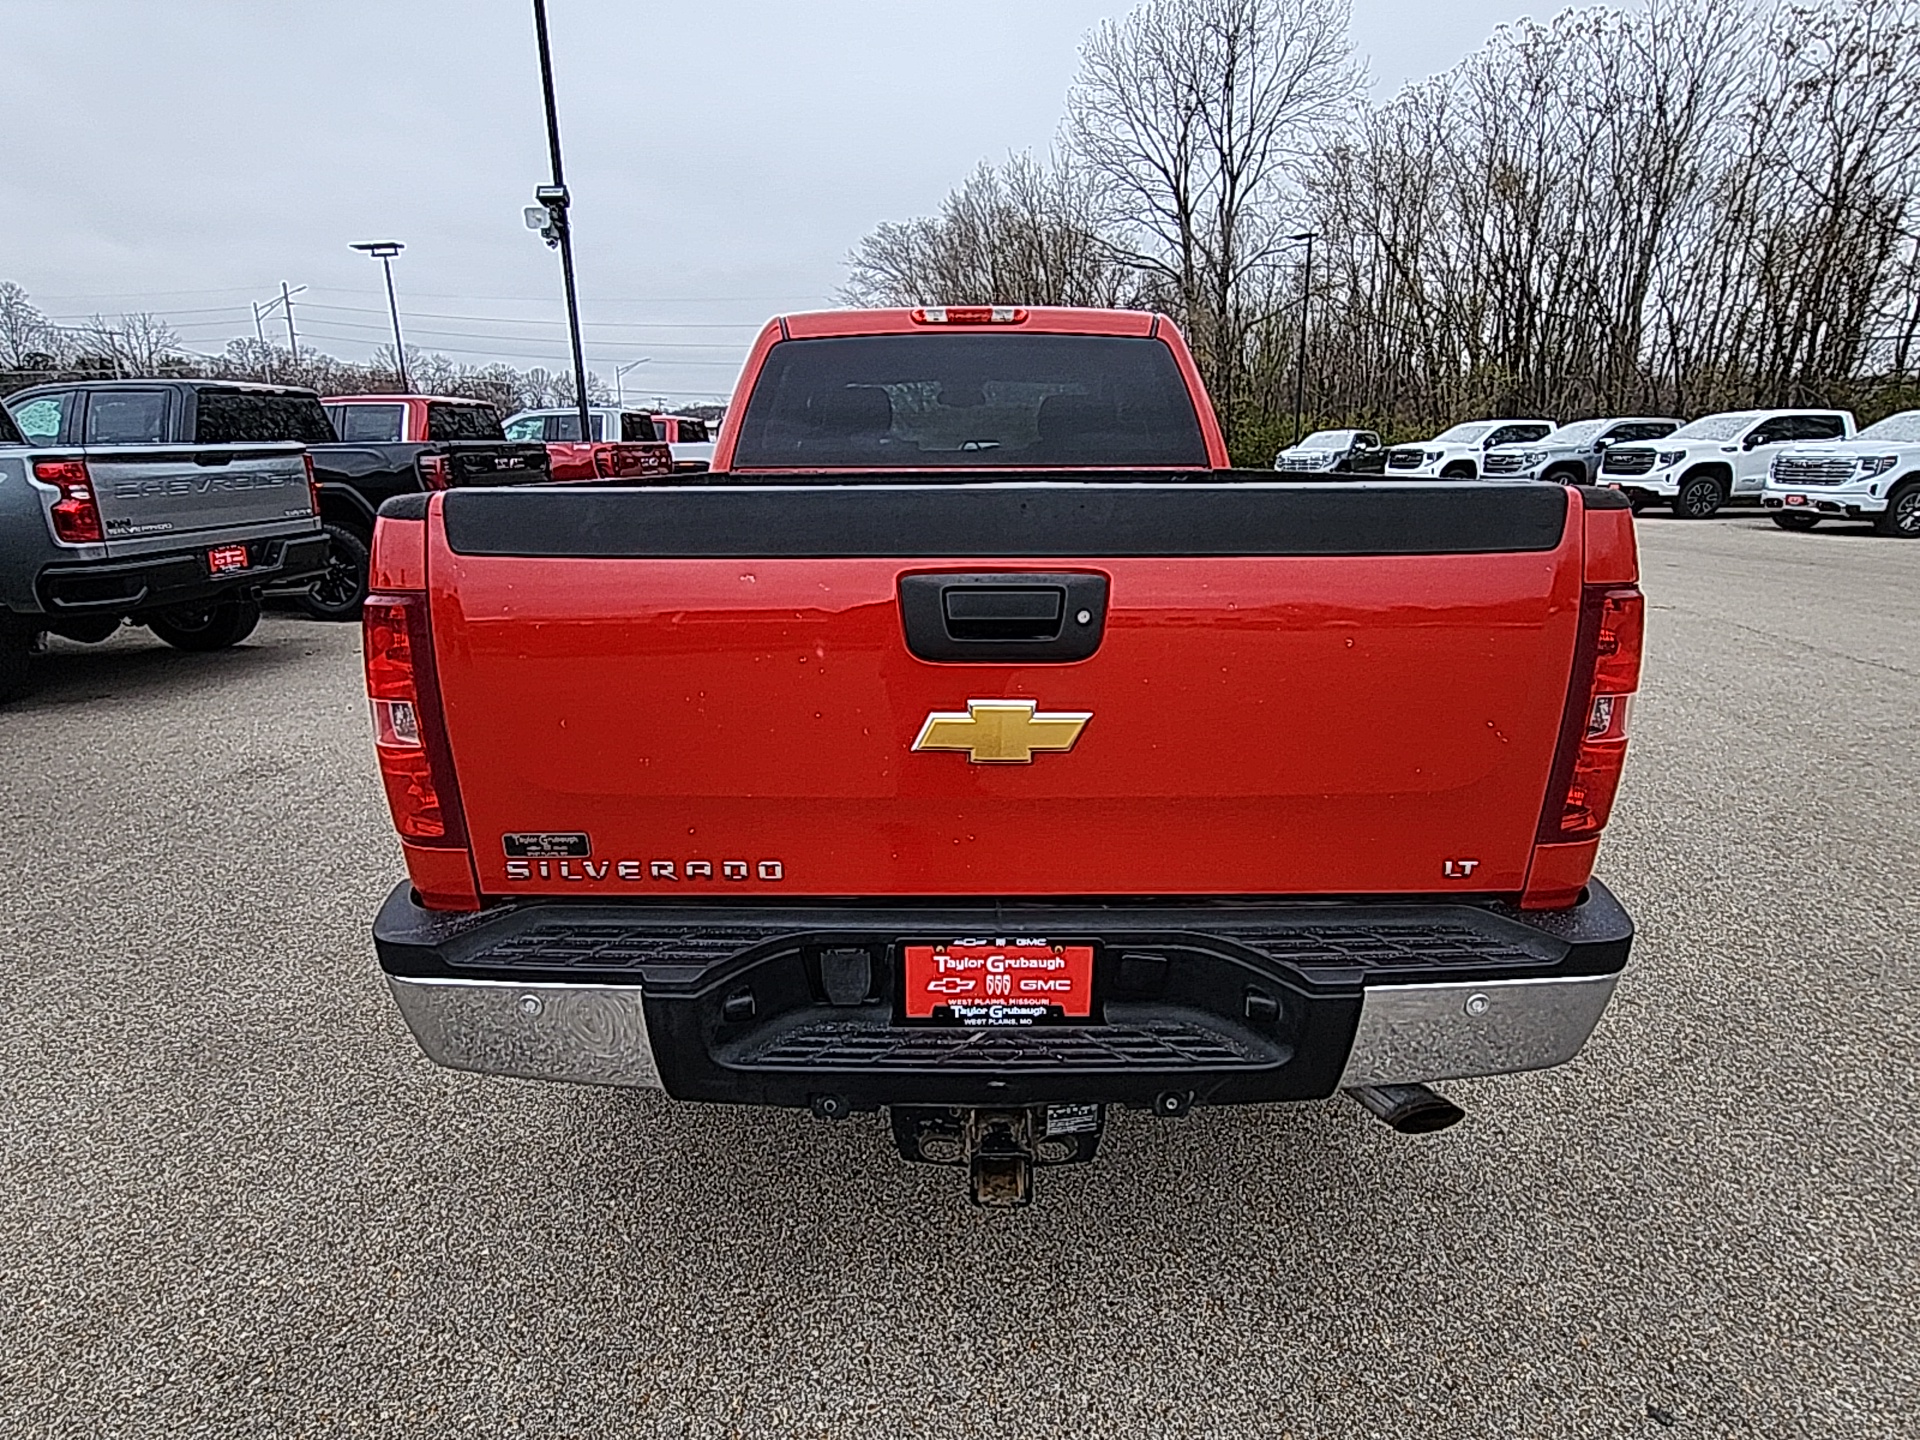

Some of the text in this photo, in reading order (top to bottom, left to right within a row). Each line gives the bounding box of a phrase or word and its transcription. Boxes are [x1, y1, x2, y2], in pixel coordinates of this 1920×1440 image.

[506, 861, 783, 880] SILVERADO
[1444, 860, 1479, 877] LT
[1016, 938, 1047, 946] GMC
[933, 955, 1065, 973] Taylor Grubaugh
[1019, 979, 1071, 991] GMC
[947, 998, 972, 1006] WEST
[1008, 998, 1050, 1006] MISSOURI
[950, 1005, 1047, 1018] Taylor Grubaugh
[964, 1018, 987, 1026] WEST
[1020, 1018, 1032, 1026] MO
